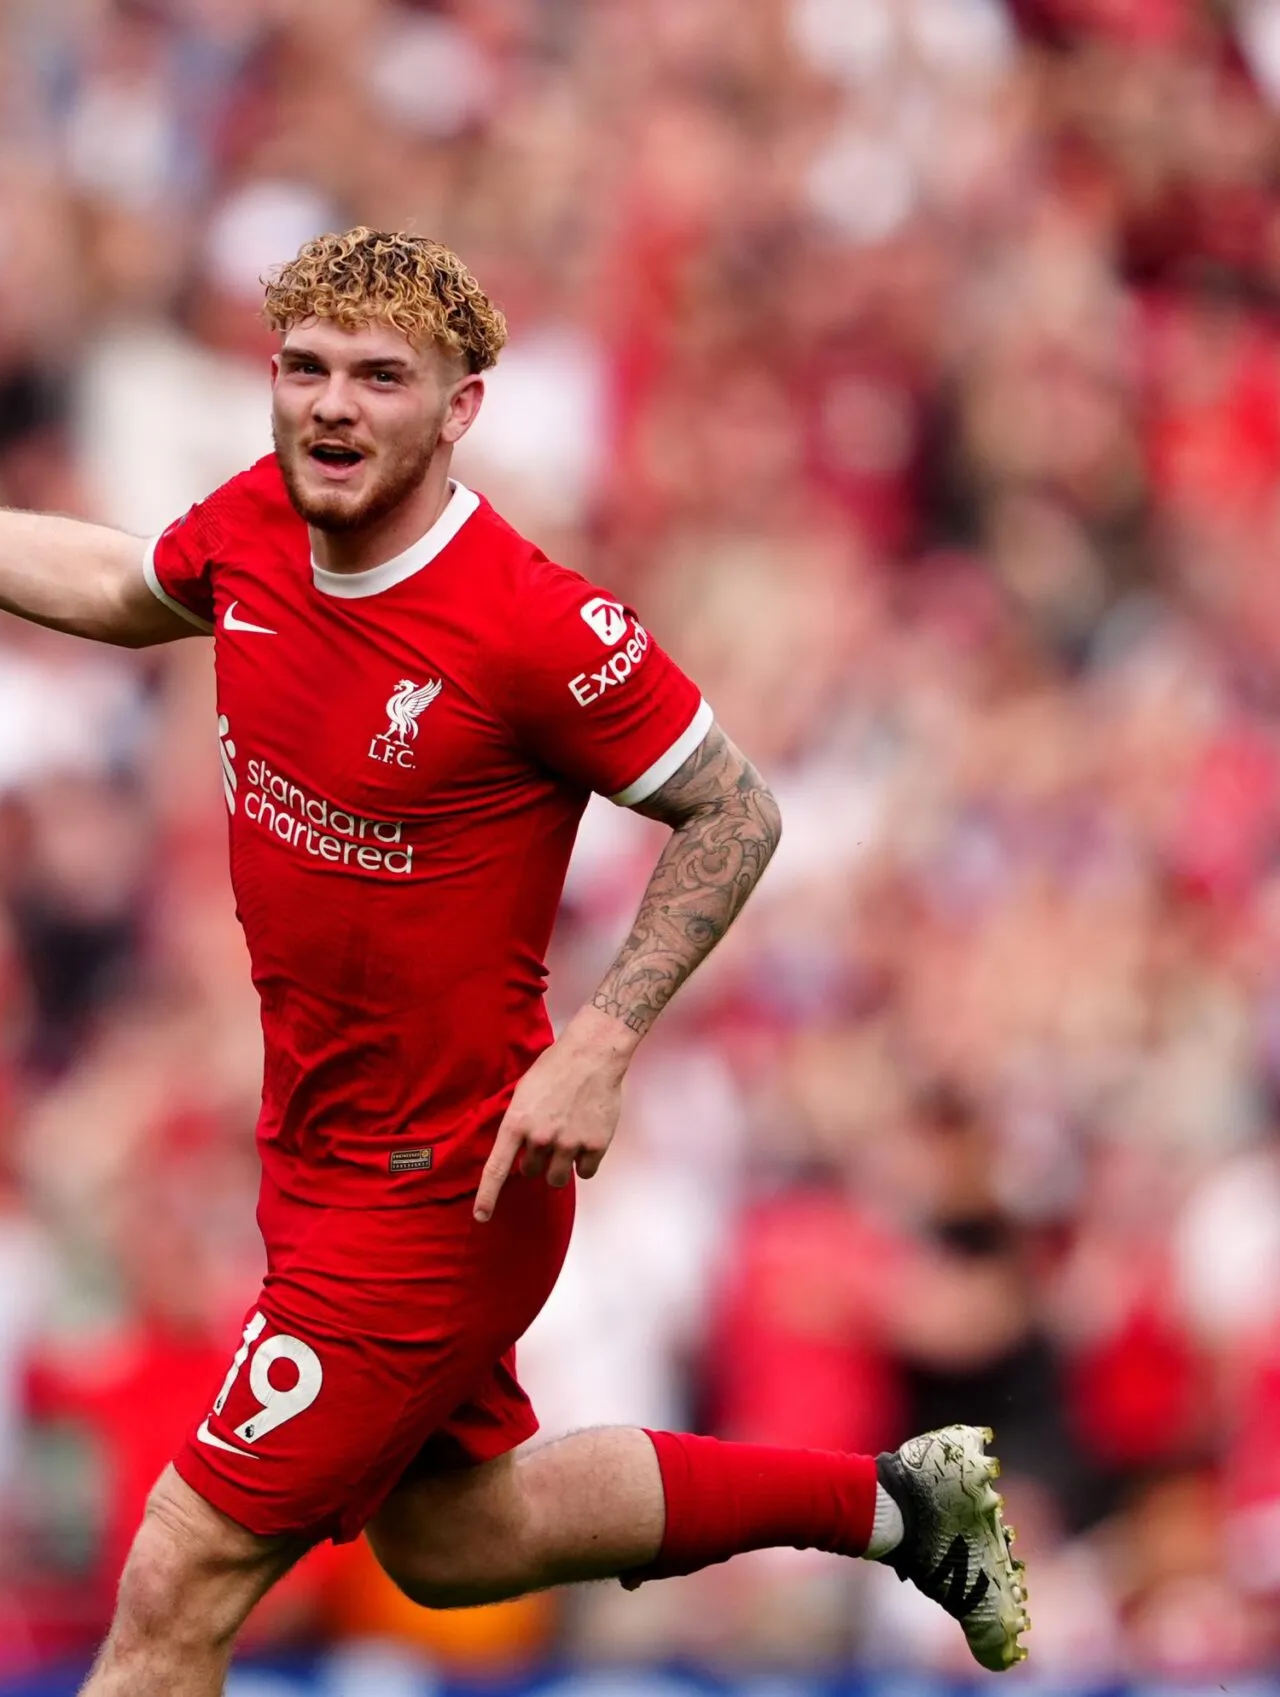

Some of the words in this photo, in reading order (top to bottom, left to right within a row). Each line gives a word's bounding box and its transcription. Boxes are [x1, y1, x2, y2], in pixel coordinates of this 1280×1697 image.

[244, 791, 414, 874] chartered
[247, 759, 403, 843] standard
[212, 1310, 324, 1445] 19
